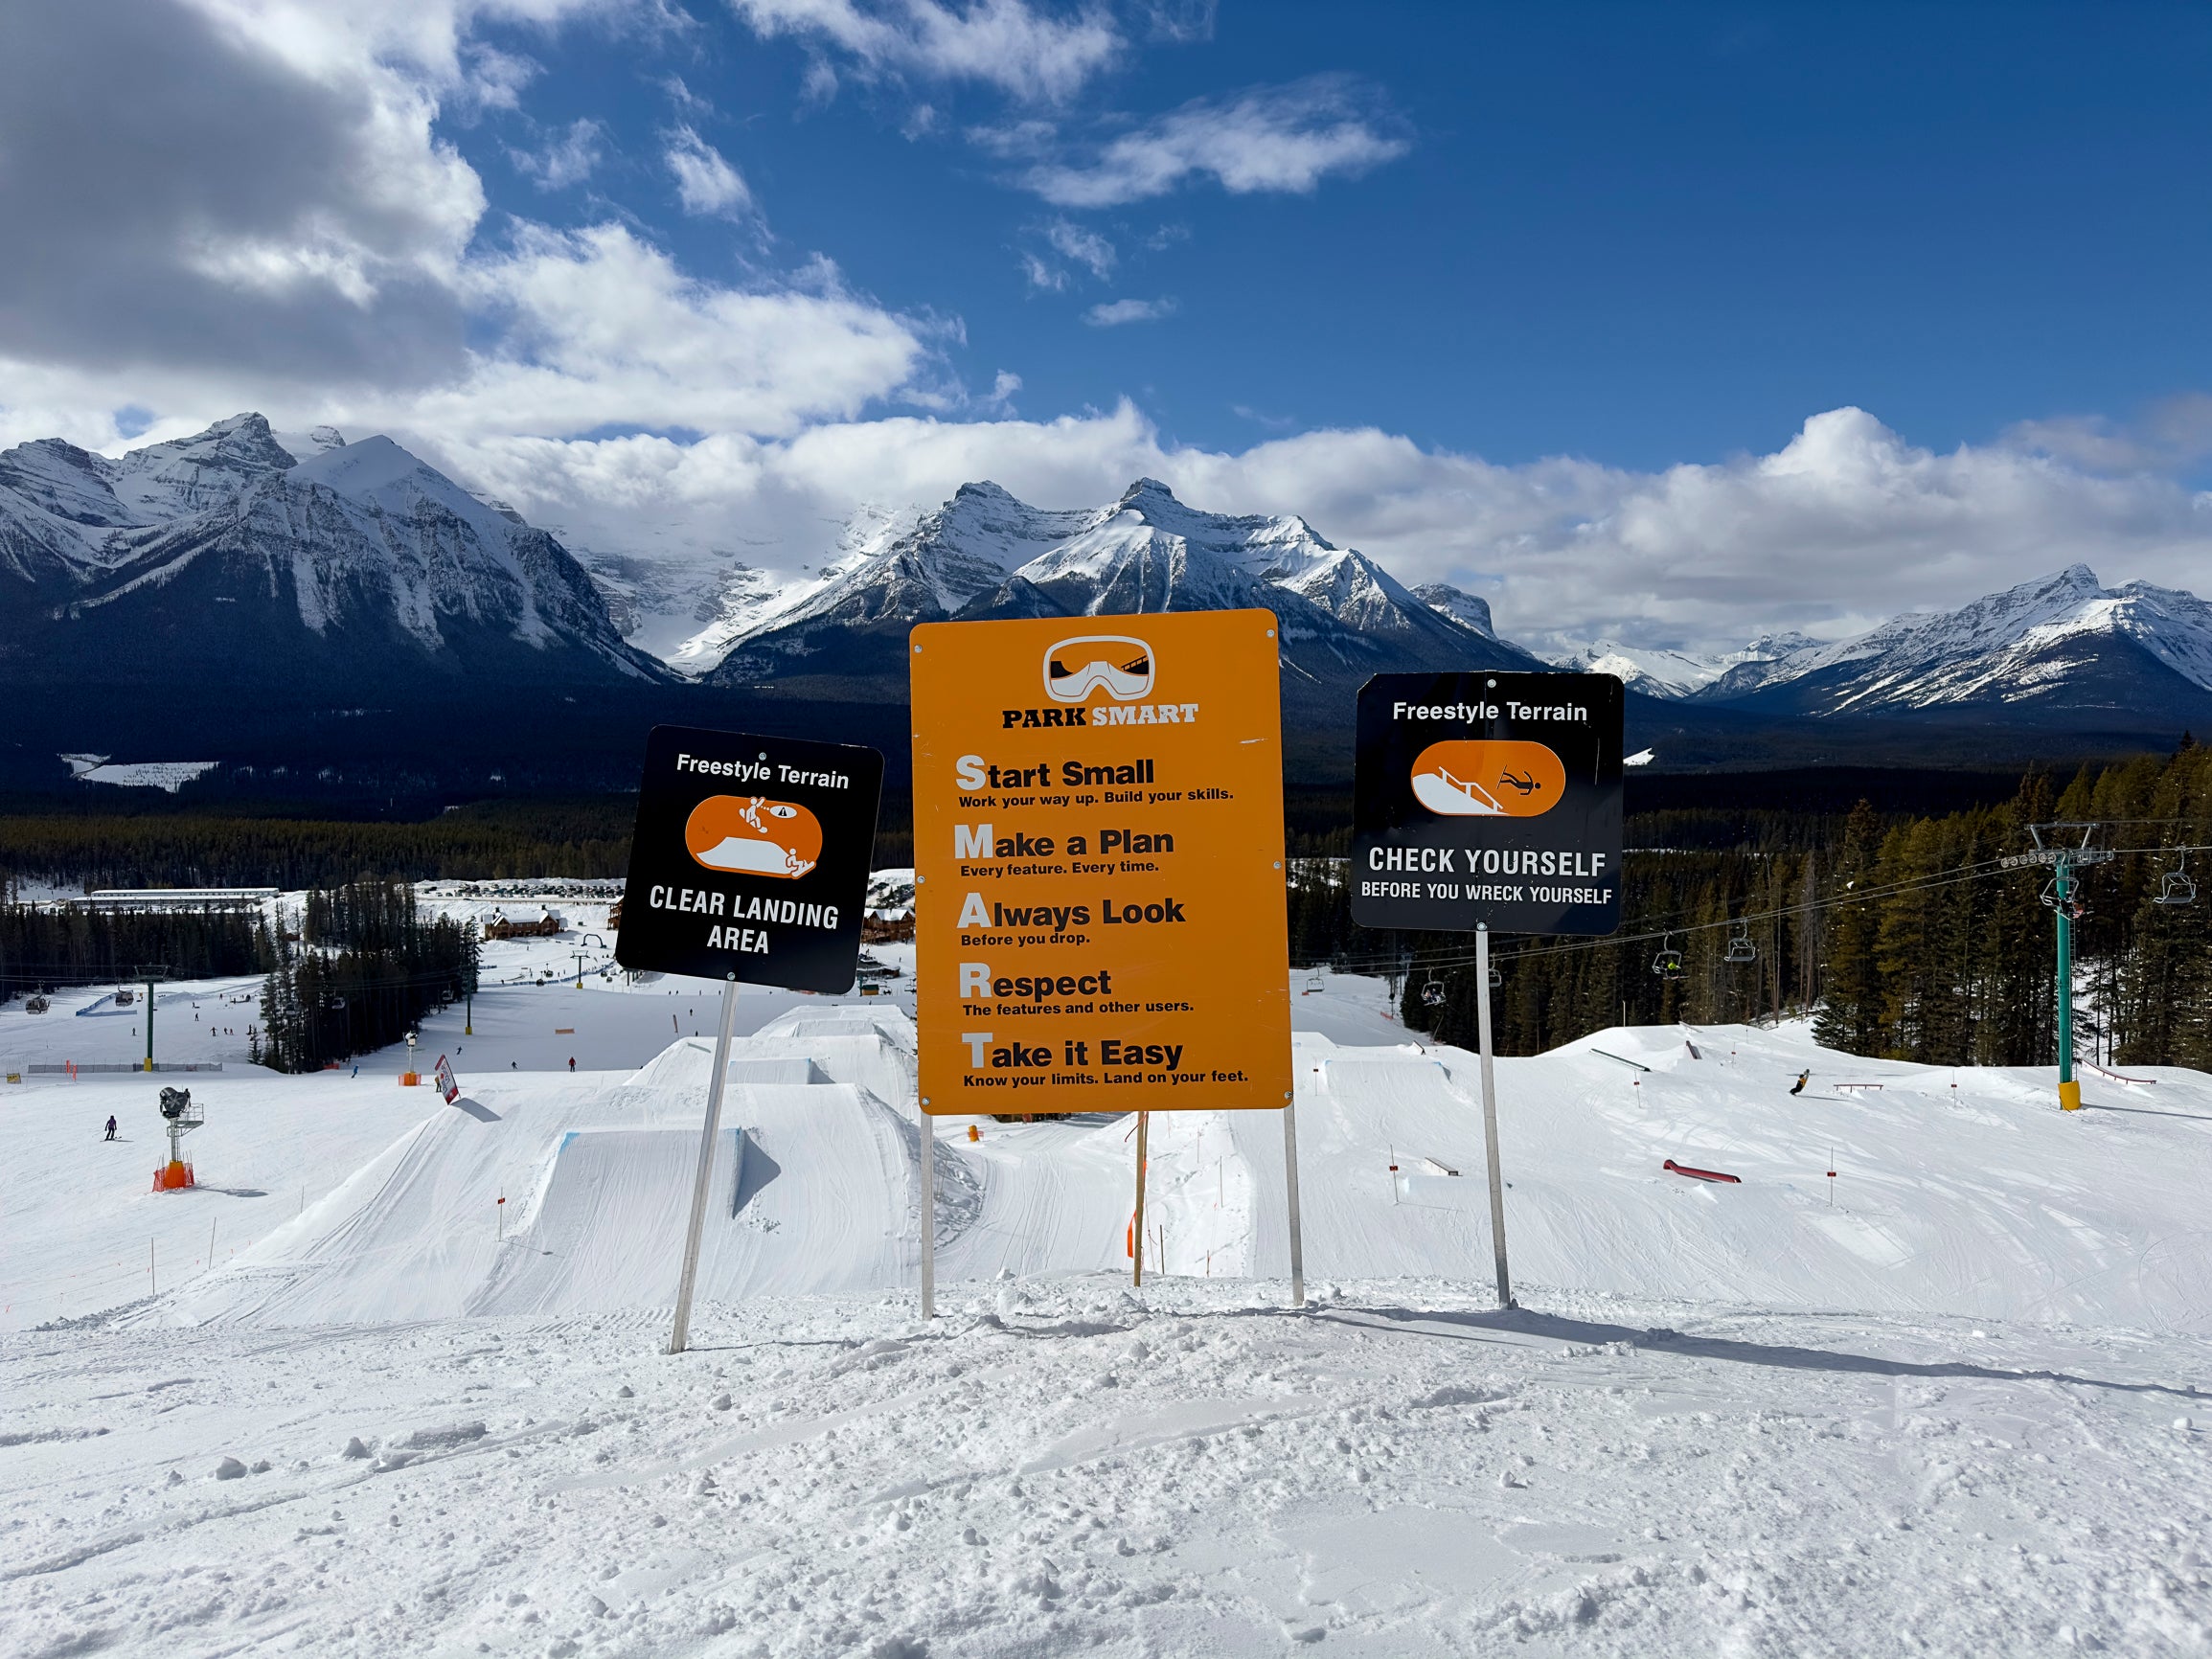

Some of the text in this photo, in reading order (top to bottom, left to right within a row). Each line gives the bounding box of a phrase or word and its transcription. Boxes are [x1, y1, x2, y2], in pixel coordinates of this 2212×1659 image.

[1003, 704, 1198, 728] PARK SMART
[1394, 702, 1586, 723] Freestyle Terrain
[677, 754, 848, 788] Freestyle Terrain
[956, 755, 1153, 790] Start Small
[959, 788, 1233, 808] Work your way up. Build your skills.
[954, 824, 1174, 858] Make a Plan
[961, 860, 1158, 878] Every feature. Every time.
[1370, 848, 1605, 876] CHECK YOURSELF
[1362, 882, 1611, 903] BEFORE YOU WRECK YOURSELF
[650, 886, 838, 929] CLEAR LANDING
[957, 893, 1186, 932] Always Look
[707, 925, 768, 954] AREA
[962, 932, 1090, 947] Before you drop.
[960, 963, 1111, 1003] Respect
[963, 1002, 1194, 1015] The features and other users.
[962, 1033, 1183, 1071] Take it Easy
[964, 1071, 1247, 1088] Know your limits. Land on your feet.
